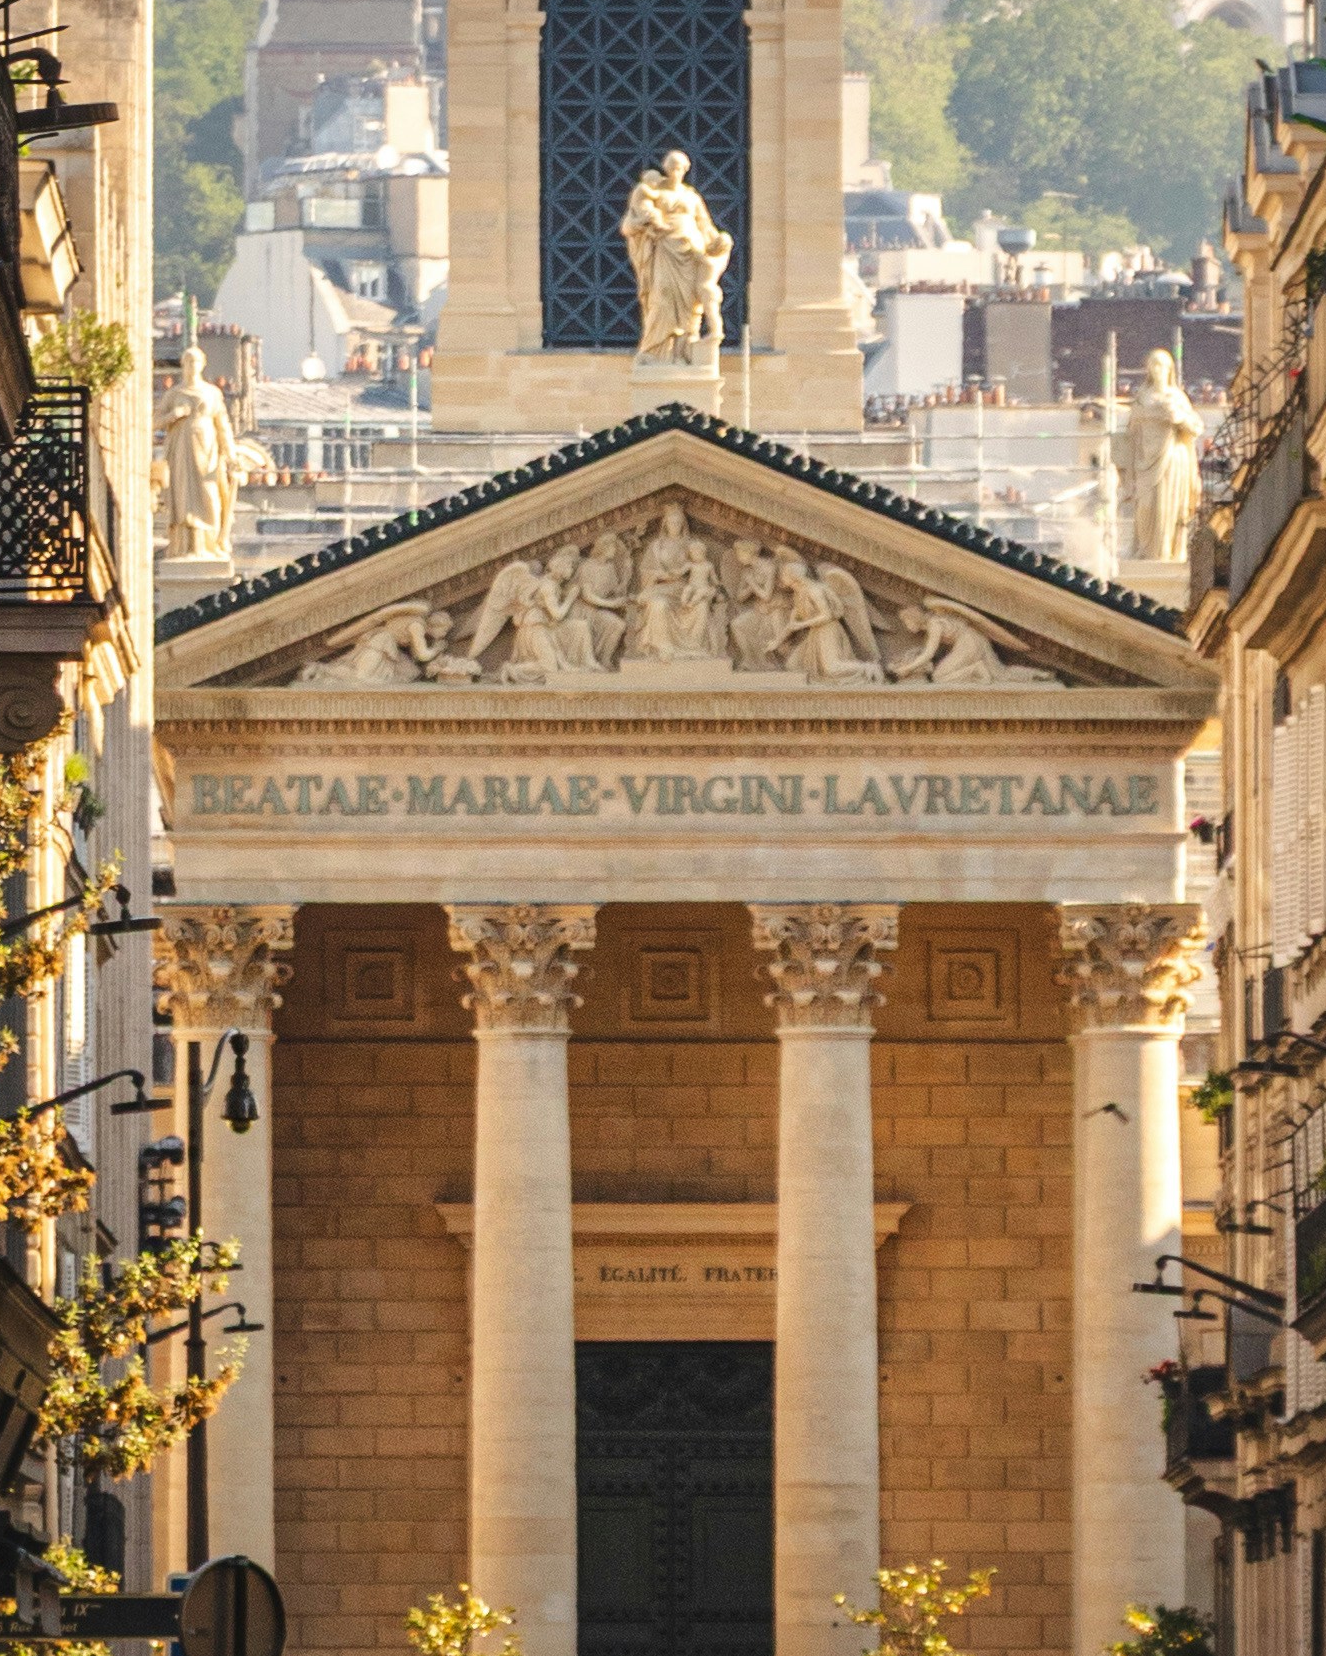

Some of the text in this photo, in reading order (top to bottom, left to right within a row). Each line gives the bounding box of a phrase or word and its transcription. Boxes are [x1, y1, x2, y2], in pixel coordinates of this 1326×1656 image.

[191, 774, 1158, 816] BEATAE MARIAE VIRGINI LAVRETANAE
